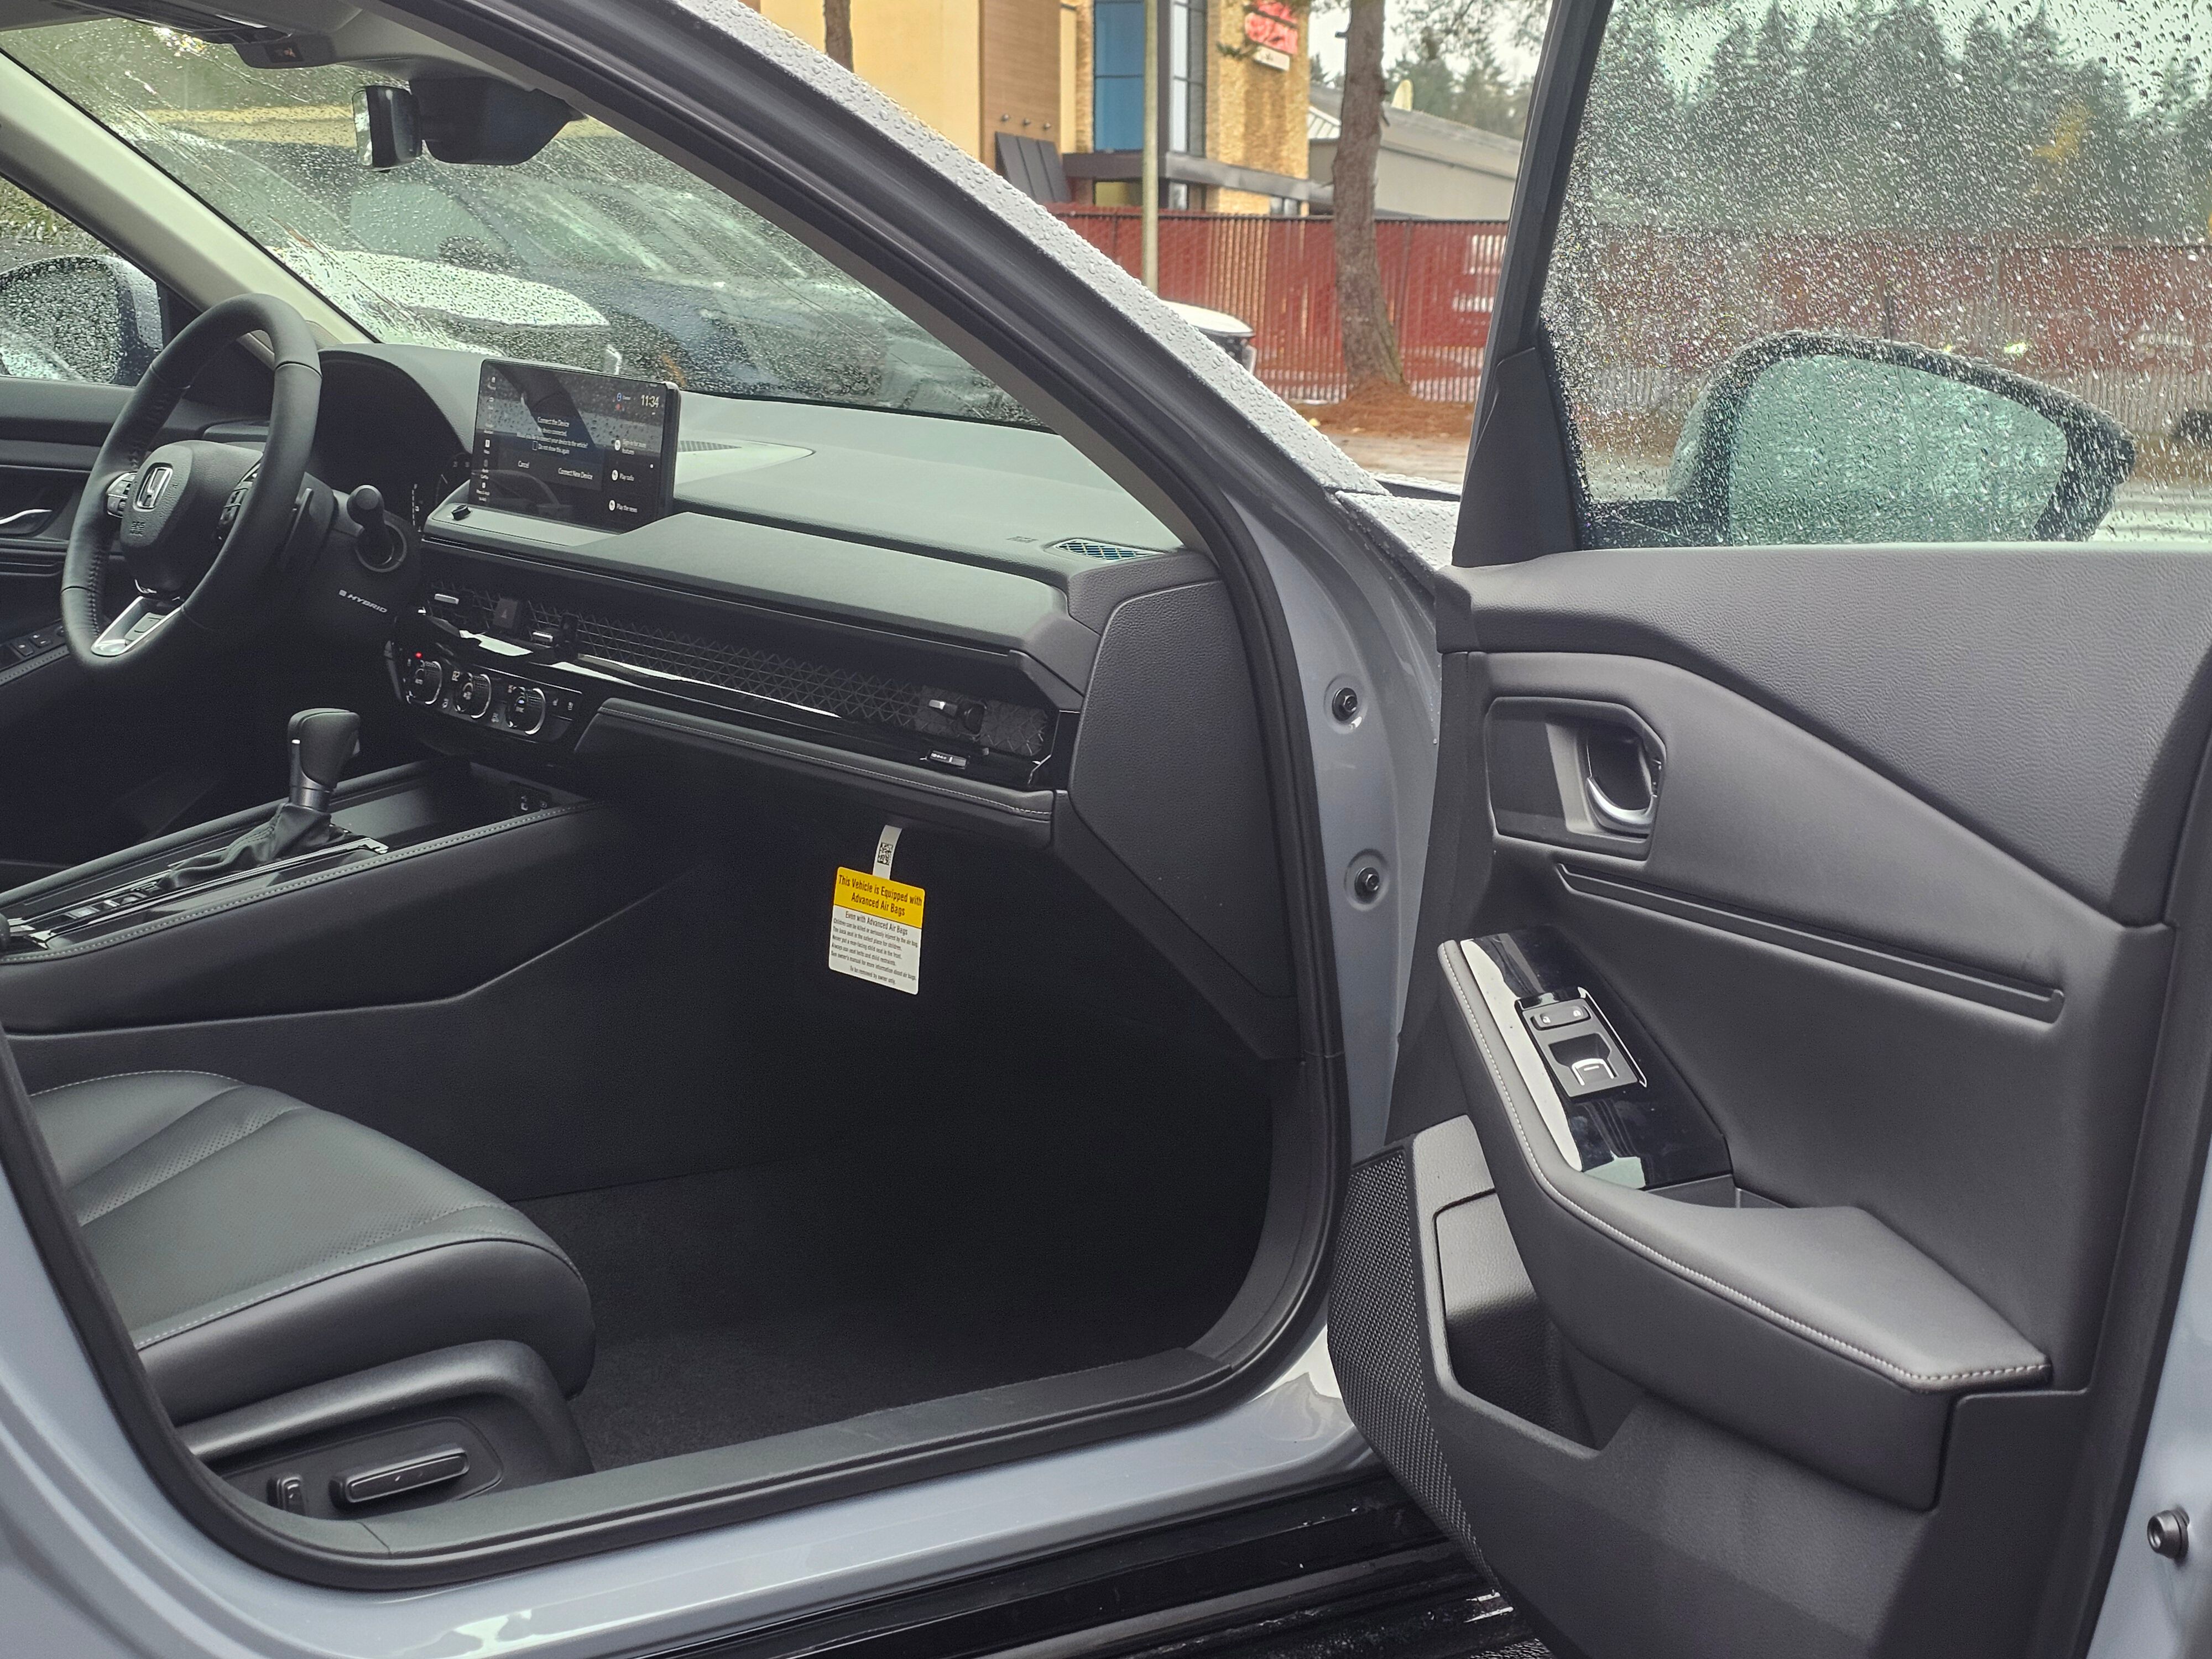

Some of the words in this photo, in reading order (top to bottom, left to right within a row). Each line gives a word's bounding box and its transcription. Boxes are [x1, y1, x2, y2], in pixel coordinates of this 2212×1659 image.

[518, 460, 530, 468] Cancel
[558, 468, 573, 476] Connect
[581, 471, 593, 480] Device
[347, 594, 388, 613] HYBRID
[839, 875, 851, 886] This
[853, 878, 873, 893] Vehicle
[874, 885, 879, 895] is
[881, 886, 908, 902] Equipped
[910, 895, 922, 906] with
[851, 893, 879, 909] Advanced
[880, 901, 889, 911] Air
[891, 904, 905, 917] Bags
[846, 911, 856, 920] Even
[867, 917, 888, 930] Advanced
[897, 925, 908, 936] Bags
